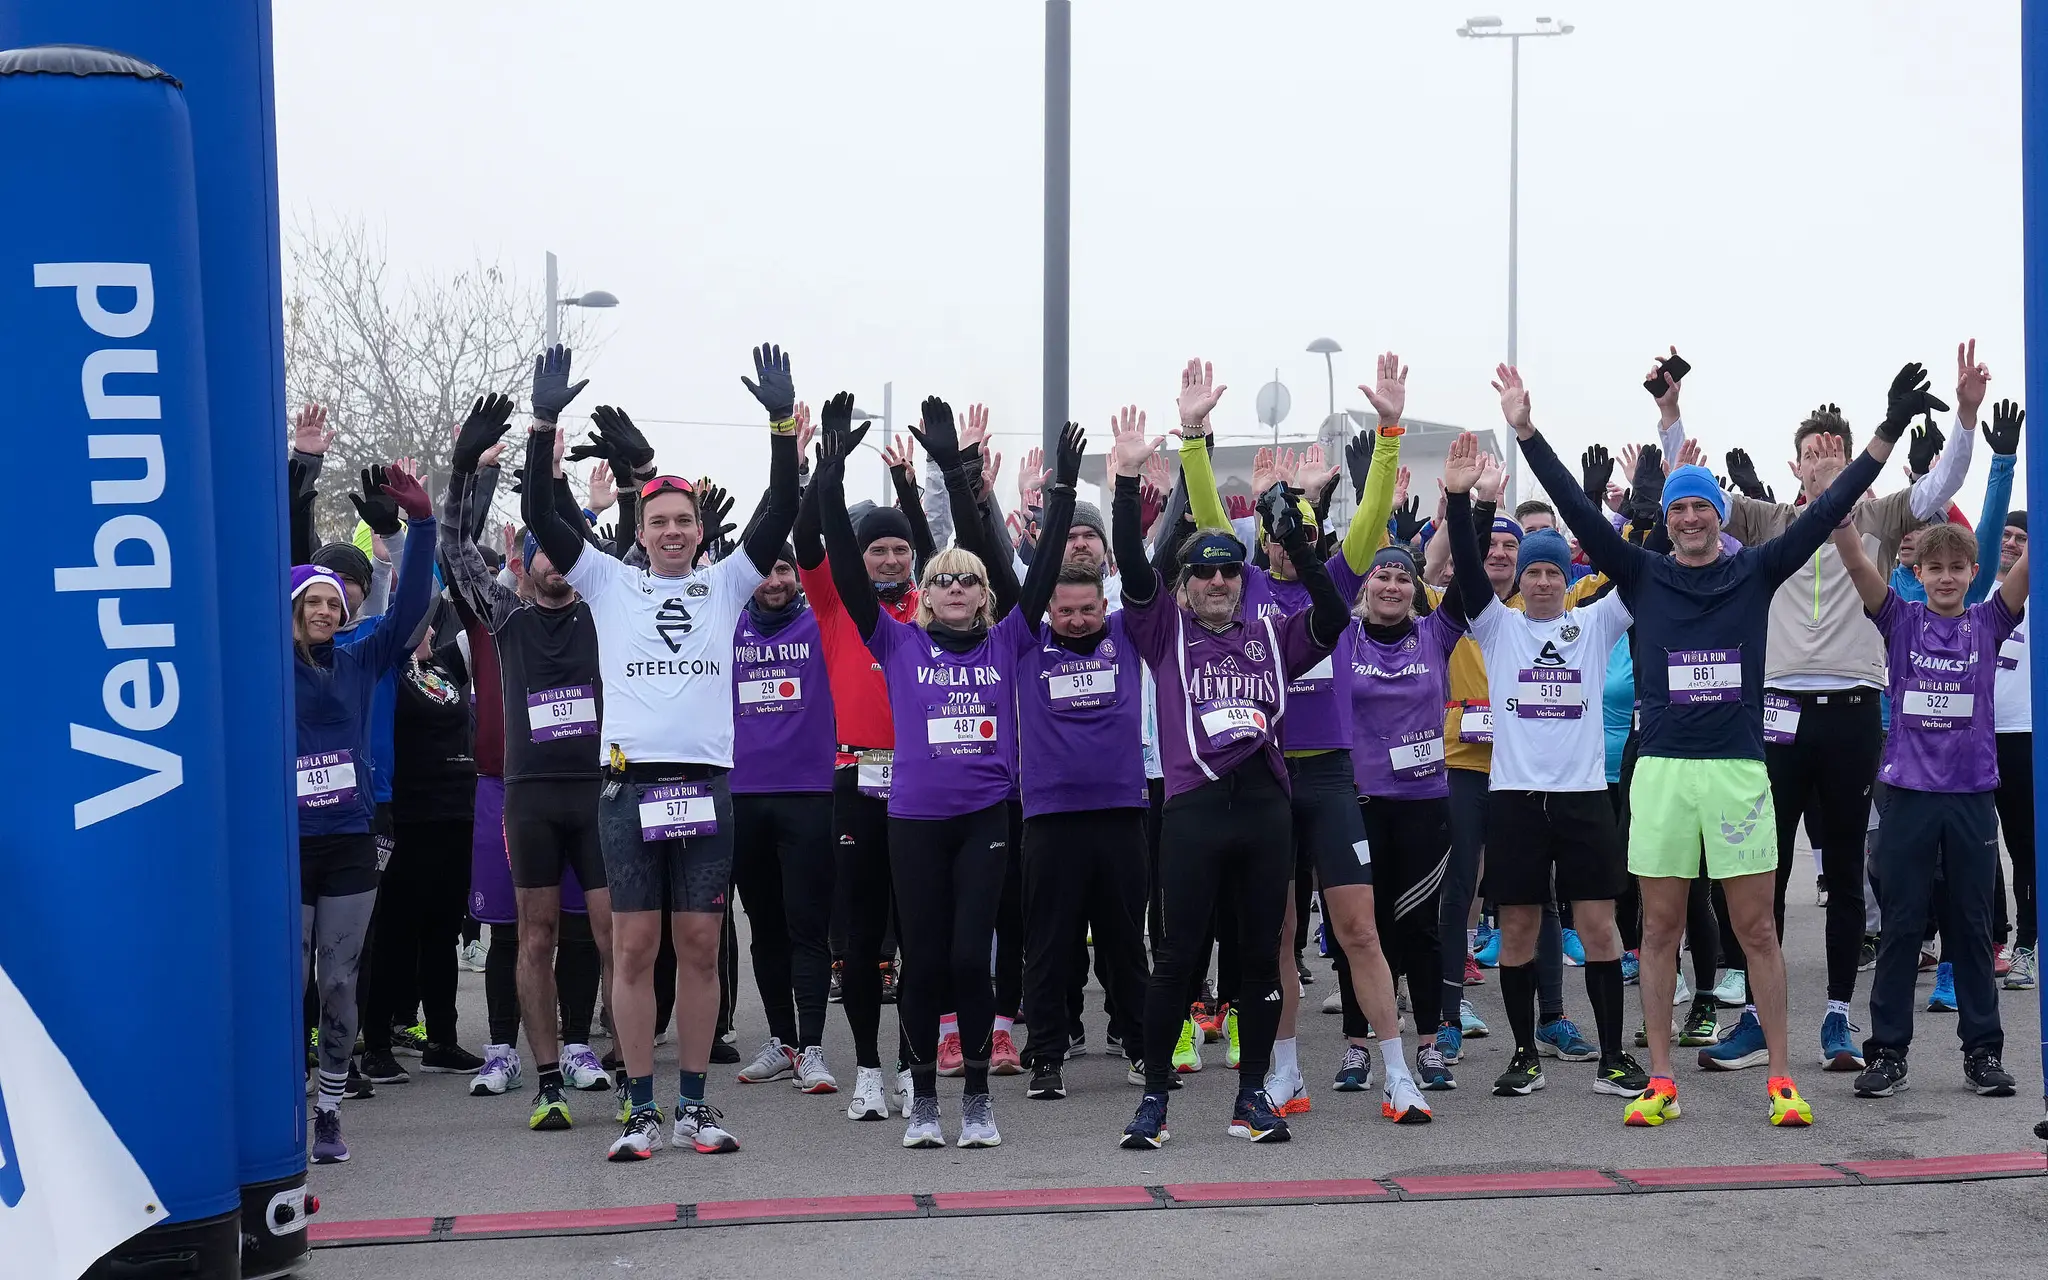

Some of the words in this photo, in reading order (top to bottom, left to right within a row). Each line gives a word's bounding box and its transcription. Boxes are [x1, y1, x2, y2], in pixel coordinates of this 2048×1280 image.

[33, 262, 184, 831] Verbund
[778, 642, 810, 661] RUN
[1710, 651, 1726, 662] RUN
[626, 659, 720, 677] STEELCOIN
[1085, 660, 1101, 670] RUN
[771, 668, 787, 678] RUN
[1557, 671, 1572, 681] RUN
[1693, 666, 1715, 681] 661
[1073, 673, 1093, 688] 518
[1687, 680, 1728, 688] ANDREAS
[566, 688, 582, 698] RUN
[761, 681, 775, 694] 29
[1540, 684, 1562, 697] 519
[1944, 682, 1961, 692] RUN
[948, 691, 980, 704] 2024
[1071, 698, 1100, 707] Verbund
[1240, 698, 1255, 708] RUN
[1689, 692, 1722, 702] Verbund
[1926, 694, 1949, 709] 522
[552, 702, 573, 717] 637
[756, 704, 783, 713] Verbund
[969, 704, 986, 714] RUN
[1227, 708, 1250, 720] 484
[1535, 709, 1566, 717] Verbund
[953, 719, 975, 733] 487
[1921, 719, 1952, 729] Verbund
[551, 726, 583, 738] Verbund
[1229, 729, 1258, 740] Verbund
[950, 747, 982, 755] Verbund
[1413, 742, 1431, 758] 520
[322, 753, 339, 765] RUN
[307, 768, 330, 785] 481
[882, 766, 893, 779] 8
[681, 786, 698, 796] RUN
[306, 795, 340, 808] Verbund
[666, 800, 688, 816] 577
[664, 827, 697, 838] Verbund
